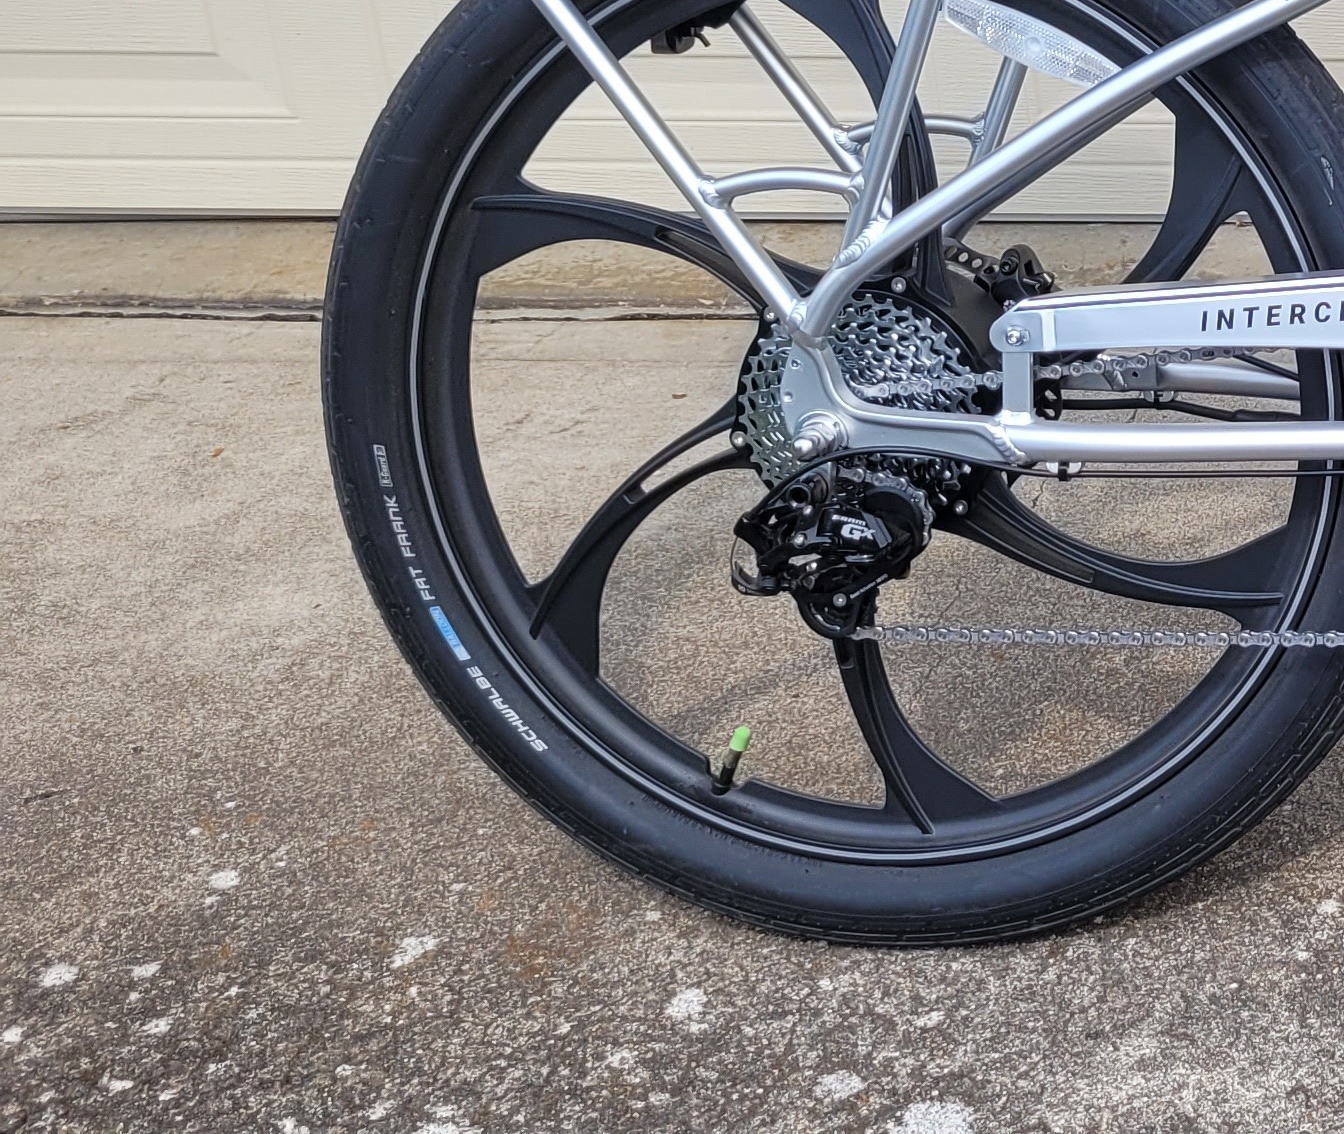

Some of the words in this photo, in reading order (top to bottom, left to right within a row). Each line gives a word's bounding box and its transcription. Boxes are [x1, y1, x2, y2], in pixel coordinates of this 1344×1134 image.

[383, 494, 416, 558] FRANK
[841, 523, 876, 541] GX
[408, 566, 436, 601] FAT
[467, 666, 548, 752] SCHWALBE
